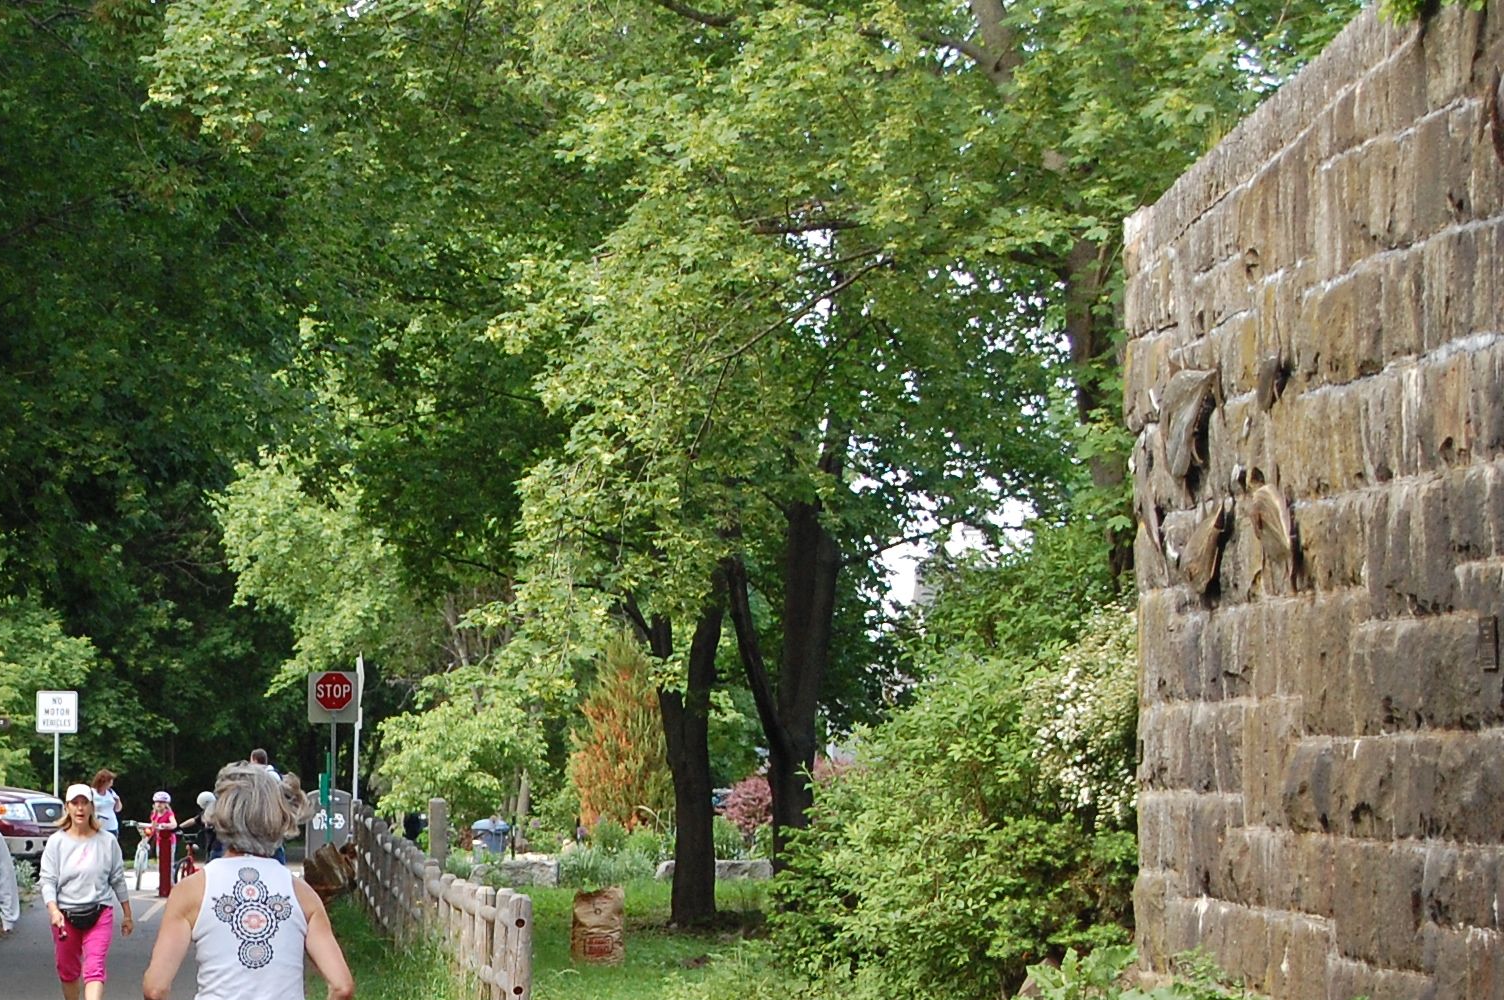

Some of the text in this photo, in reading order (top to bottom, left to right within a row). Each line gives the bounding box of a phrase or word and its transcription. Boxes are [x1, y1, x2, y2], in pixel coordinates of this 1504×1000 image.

[316, 684, 351, 698] STOP
[52, 697, 63, 705] NO
[44, 708, 70, 716] MOTOR
[42, 719, 71, 727] VEHICLES
